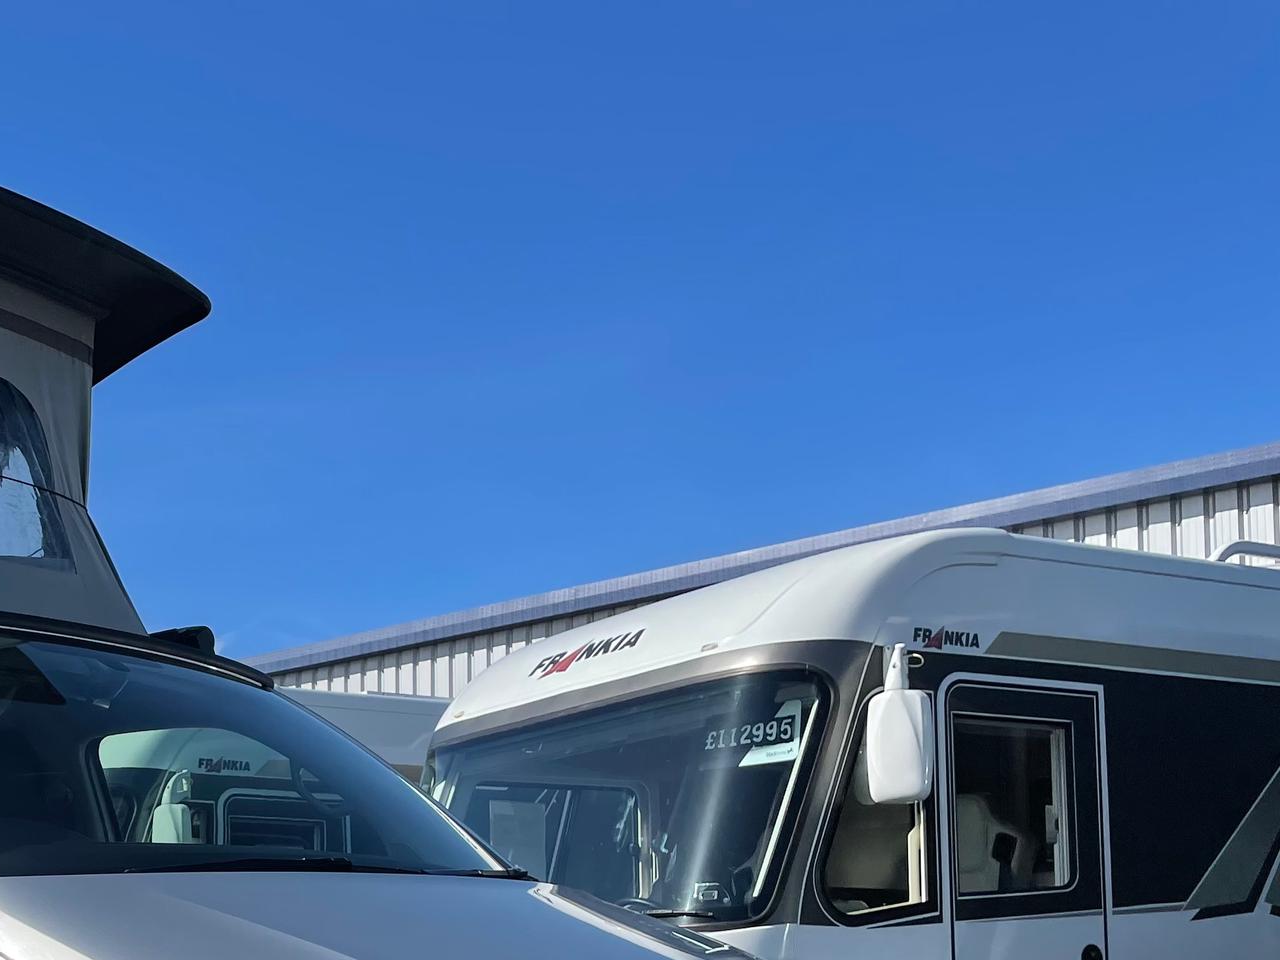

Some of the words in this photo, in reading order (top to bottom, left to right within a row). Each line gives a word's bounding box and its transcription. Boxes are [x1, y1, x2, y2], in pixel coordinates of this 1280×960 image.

[912, 625, 980, 649] FRANKIA
[528, 628, 646, 680] FRANKIA
[704, 719, 792, 750] £112995
[198, 756, 251, 773] FRANKIA
